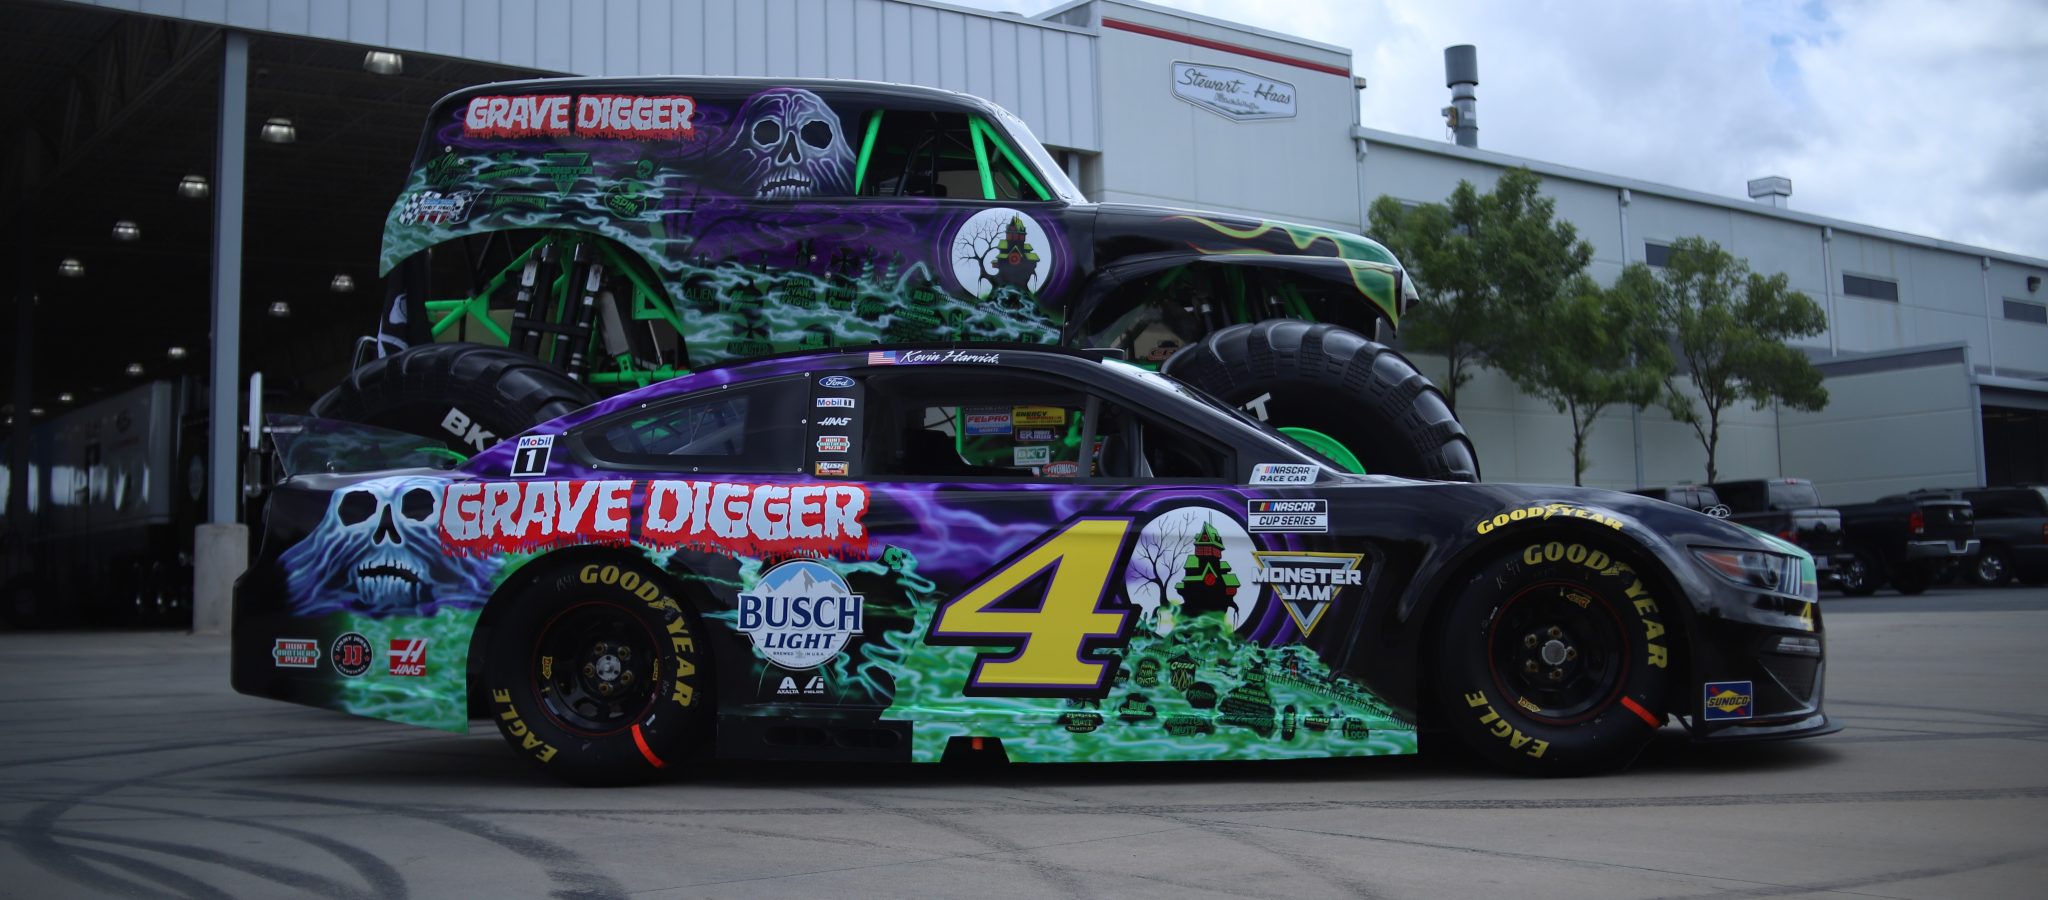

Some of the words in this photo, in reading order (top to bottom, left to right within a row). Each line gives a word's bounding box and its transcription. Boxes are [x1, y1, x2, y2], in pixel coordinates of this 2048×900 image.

[1177, 68, 1245, 93] Stewart
[1254, 83, 1291, 105] Haas
[465, 96, 571, 132] GRAVE
[577, 96, 694, 132] DIGGER
[900, 350, 940, 363] Kevin
[941, 351, 999, 364] Harvick
[826, 377, 849, 386] Ford
[817, 399, 842, 407] Mobil
[441, 407, 504, 452] BK
[817, 417, 852, 426] HAAS
[520, 437, 552, 447] Mobil
[526, 449, 537, 472] 1
[1273, 466, 1310, 475] NASCAR
[441, 480, 634, 541] GRAVE
[644, 480, 866, 541] DIGGER
[1273, 502, 1316, 512] NASCAR
[1259, 516, 1280, 525] CUP
[1281, 516, 1317, 525] SERIES
[1477, 504, 1624, 535] GOODYEAR
[1251, 567, 1362, 586] MONSTER
[933, 517, 1134, 689] 4
[1282, 585, 1332, 601] JAM
[738, 595, 863, 631] BUSCH
[1523, 541, 1669, 669] GOODYEAR
[1800, 601, 1815, 632] 4
[579, 563, 696, 708] GOODYEAR
[763, 632, 836, 649] LIGHT
[343, 645, 361, 666] JJ
[390, 664, 425, 675] HAAS
[1708, 696, 1749, 706] SUNOCO
[492, 688, 558, 763] EAGLE
[1464, 690, 1549, 759] EAGLE
